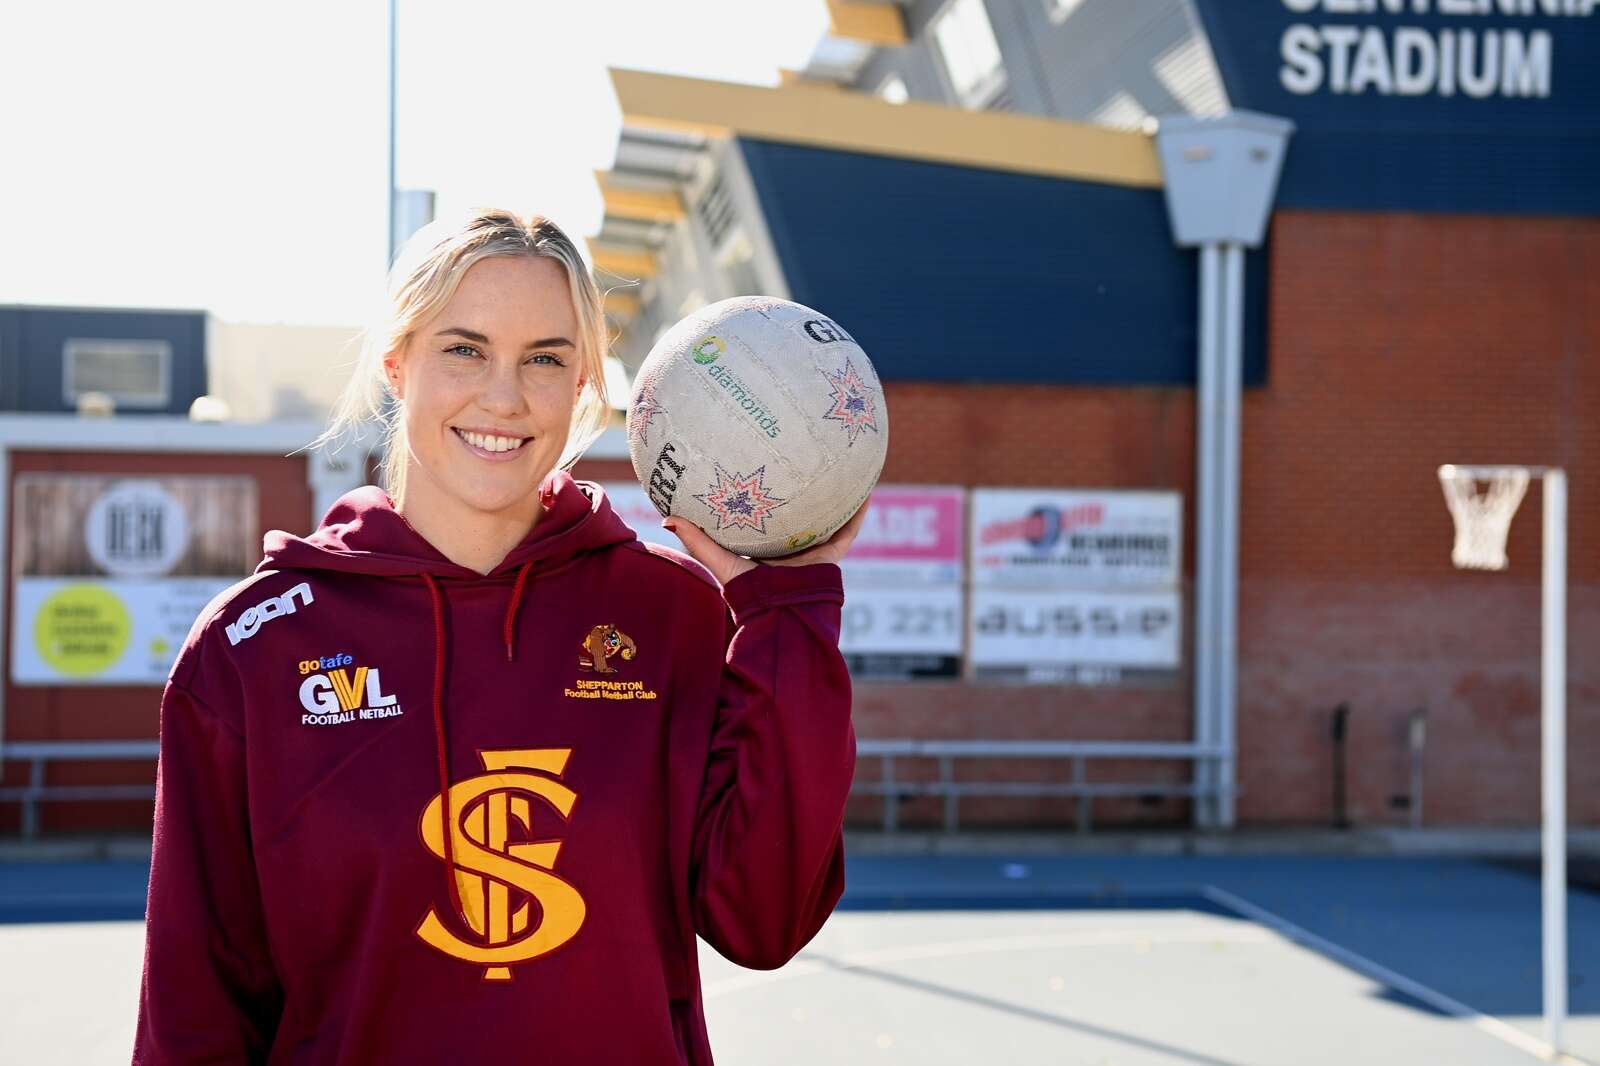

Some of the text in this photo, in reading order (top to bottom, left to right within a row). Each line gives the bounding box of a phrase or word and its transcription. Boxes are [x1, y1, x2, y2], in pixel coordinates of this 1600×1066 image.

[1280, 24, 1552, 97] STADIUM
[708, 365, 781, 438] diamonds
[299, 653, 353, 675] gotafe
[299, 667, 397, 715] GVL
[564, 688, 657, 700] Football Netball Club
[576, 680, 643, 690] SHEPPARTON
[301, 705, 404, 725] FOOTBALL NETBALL
